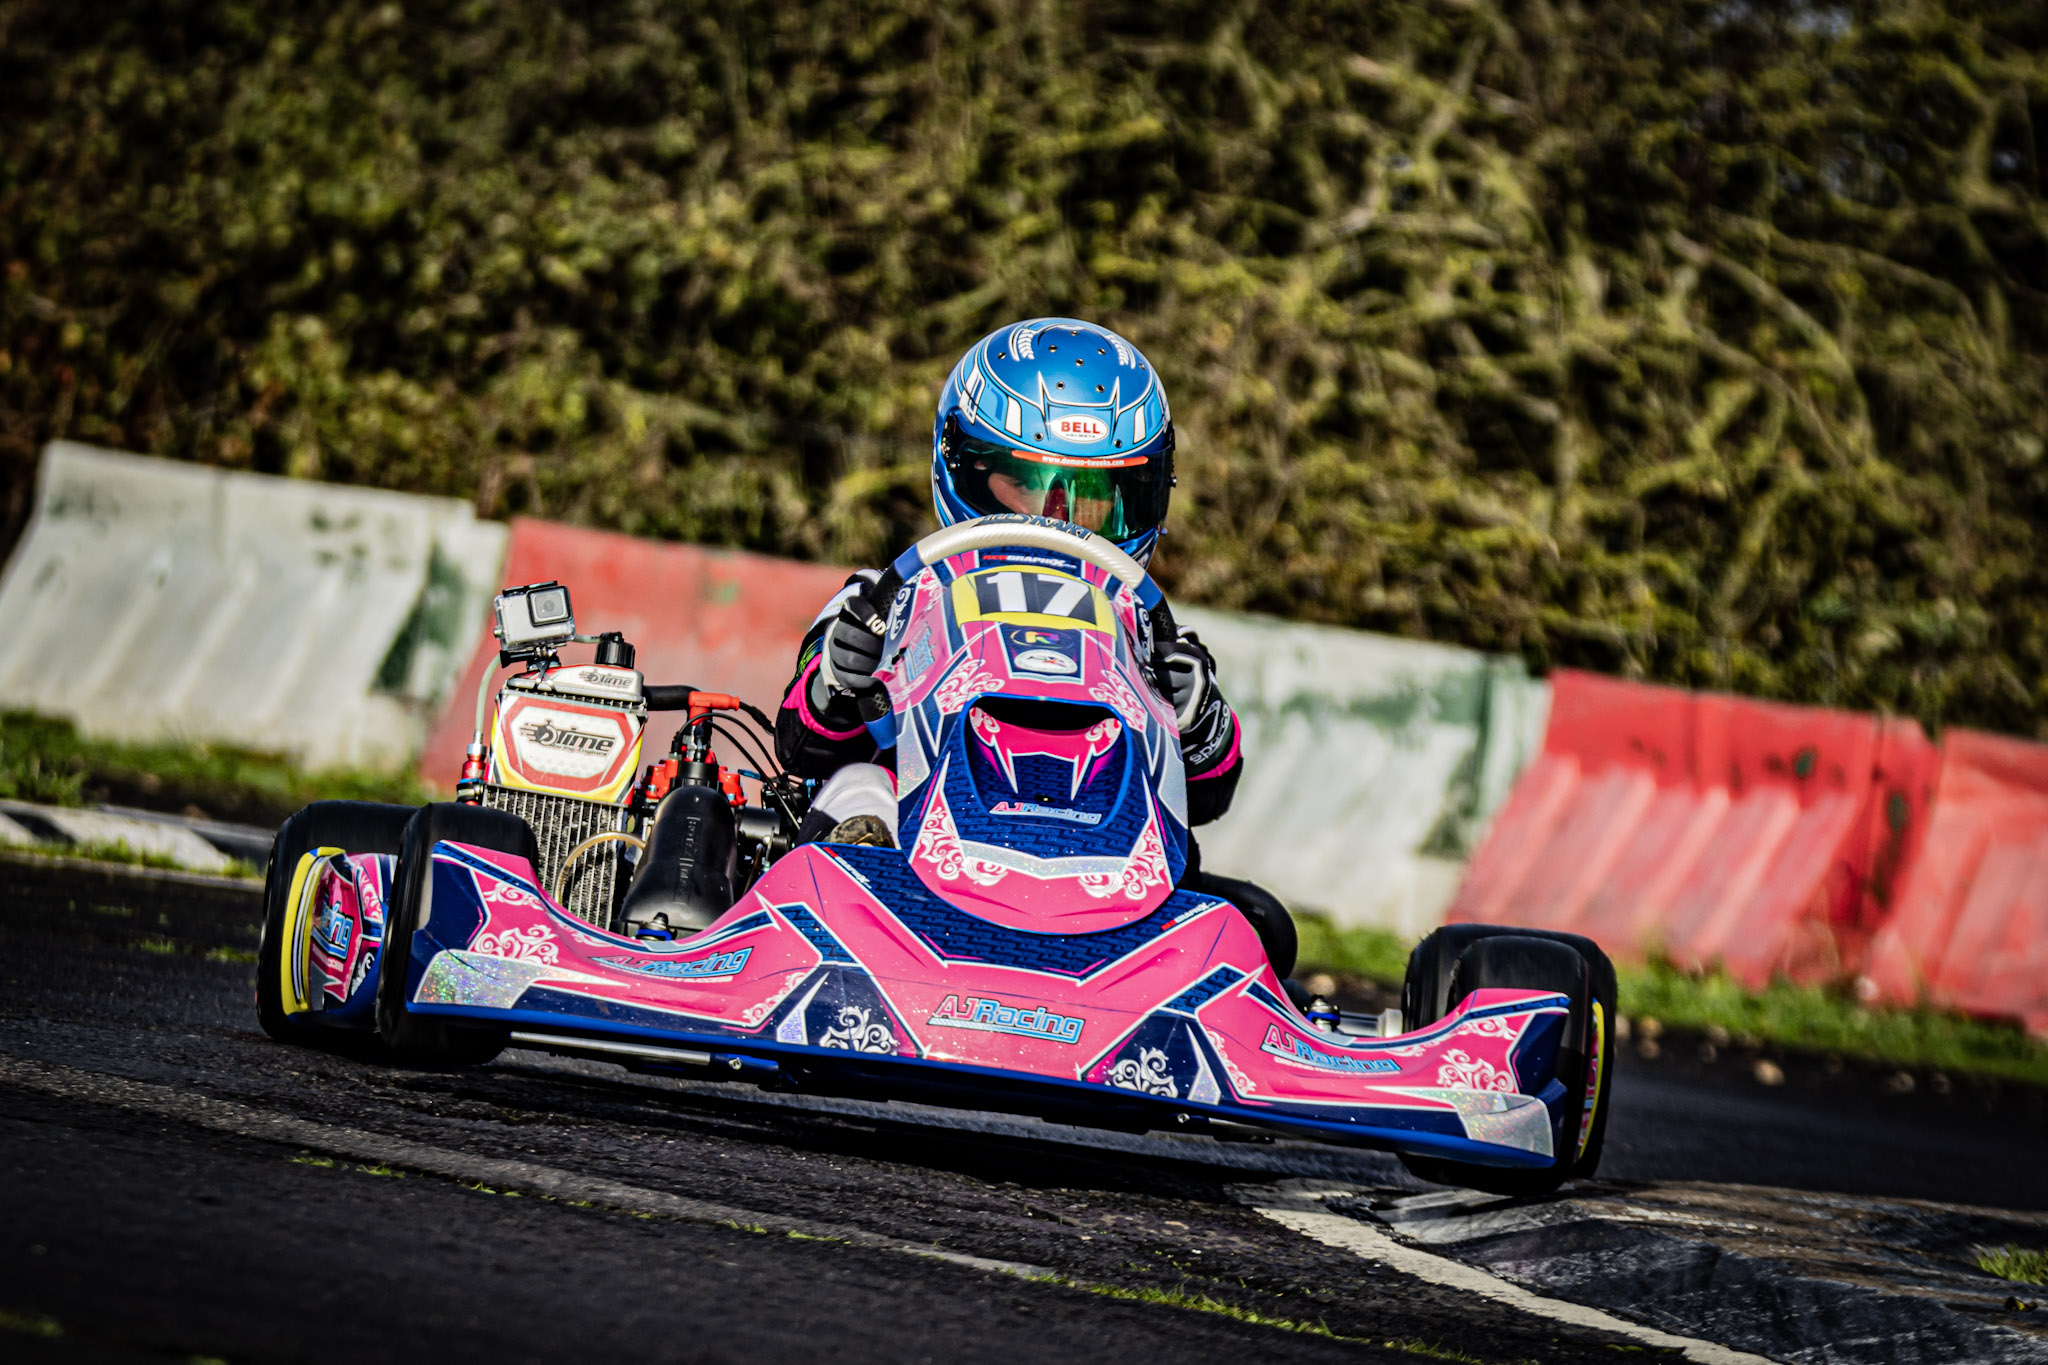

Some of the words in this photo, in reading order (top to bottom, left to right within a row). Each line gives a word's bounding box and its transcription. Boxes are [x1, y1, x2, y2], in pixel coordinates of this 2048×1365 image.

[1060, 421, 1101, 434] BELL
[985, 571, 1090, 617] 17
[1189, 704, 1231, 766] sparco
[989, 801, 1102, 824] AJRacing
[596, 946, 754, 977] AJRacing
[929, 994, 1086, 1044] AJRacing
[1261, 1022, 1402, 1072] AJRacing
